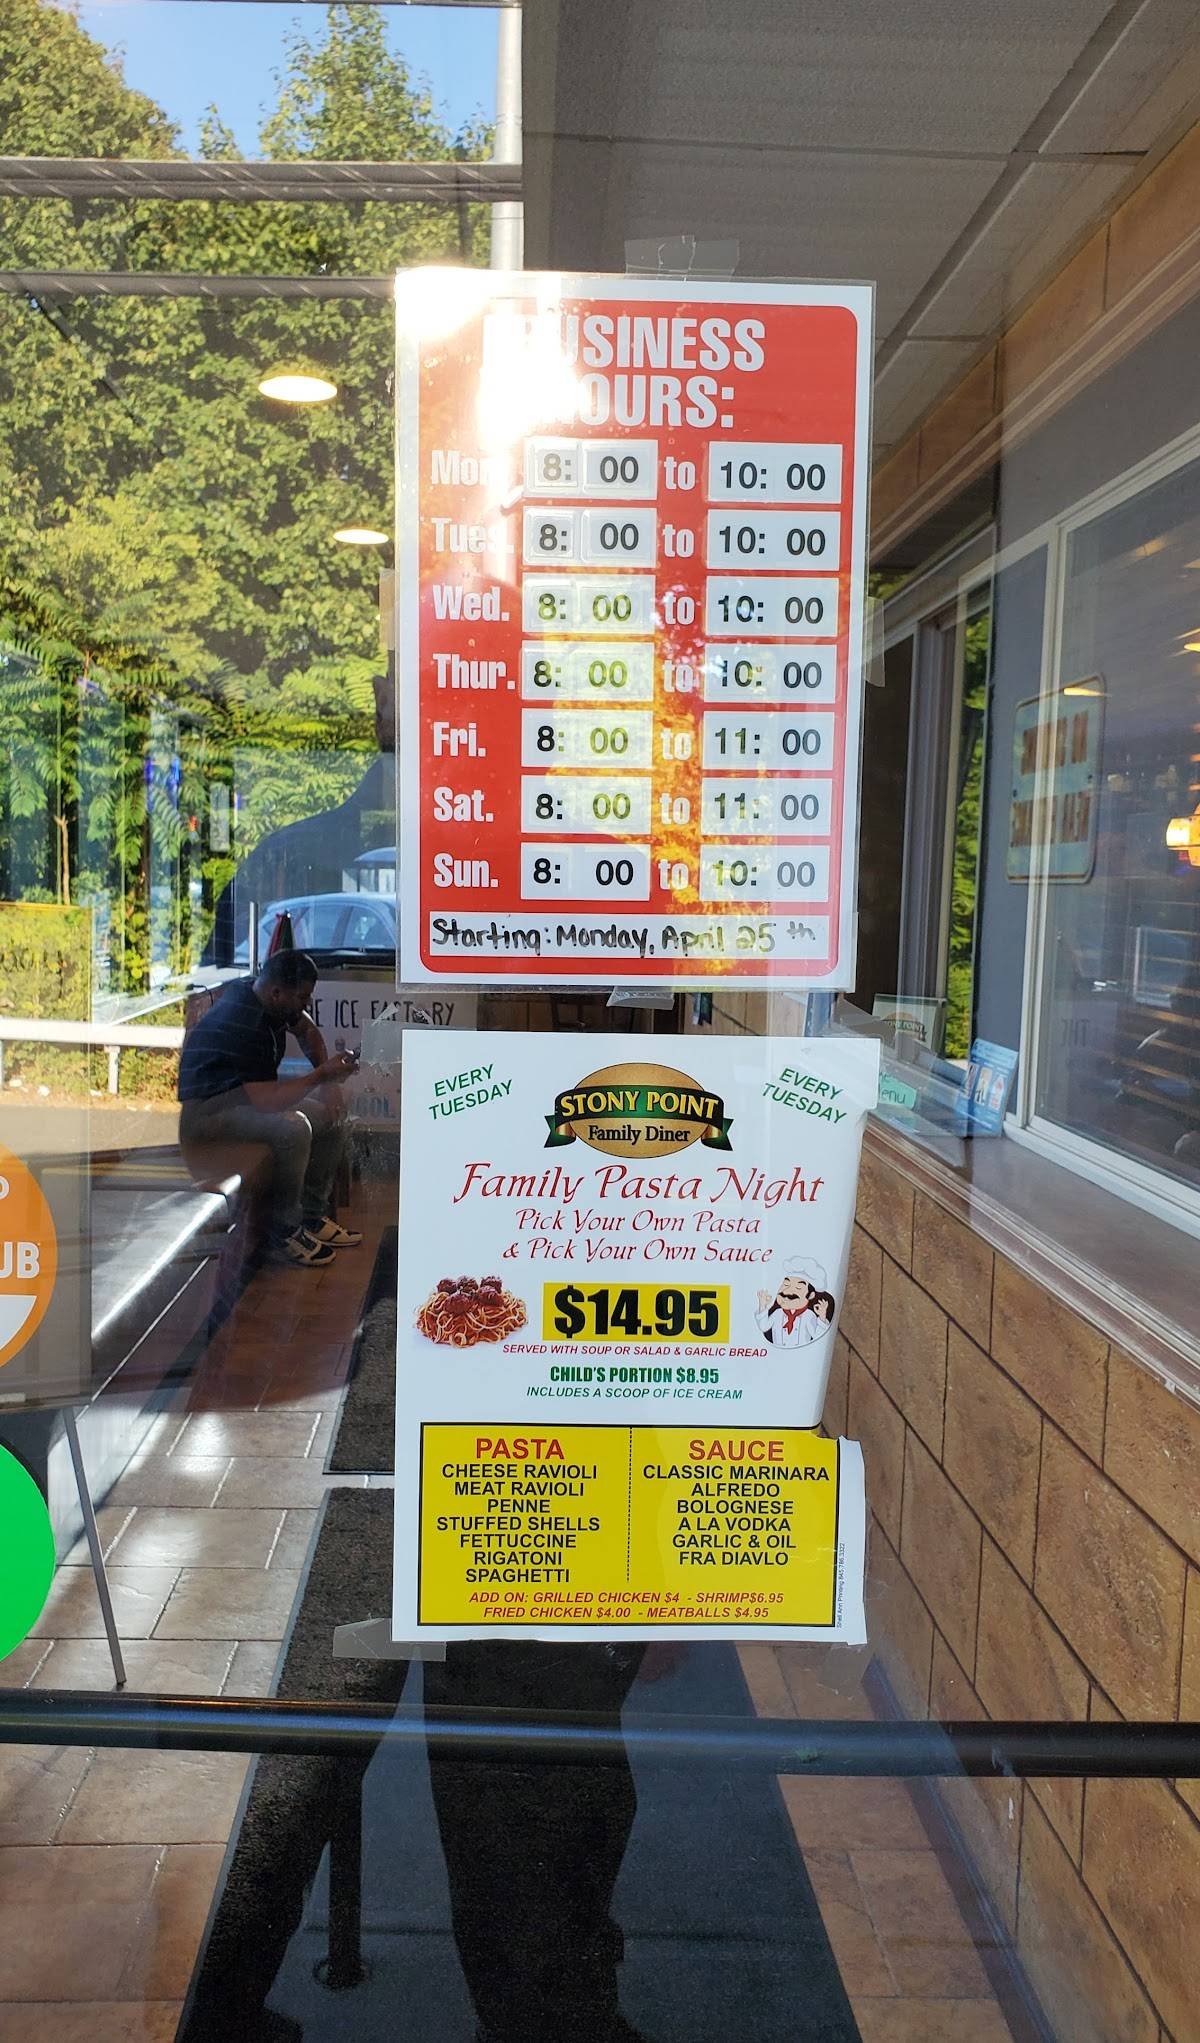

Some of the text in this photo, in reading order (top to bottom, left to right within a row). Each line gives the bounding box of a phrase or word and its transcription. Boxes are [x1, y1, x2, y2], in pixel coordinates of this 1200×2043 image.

[509, 315, 766, 372] USINESS
[540, 374, 735, 428] OURS:
[431, 449, 826, 490] Mo 8: 00 to 10: 00
[431, 517, 826, 557] Tues. 8: 00 to 10: 00
[432, 585, 824, 626] Wed. 8: 00 to 10: 00
[433, 653, 822, 693] Thur. 8: 00 to 10: 00
[433, 722, 821, 761] Fri. 8: 00 to 11: 00
[433, 787, 819, 825] Sat. 8: 00 to 11: 00
[433, 853, 815, 891] Sun. 8: 00 to 10: 00
[432, 918, 551, 956] Starting:
[556, 924, 654, 958] Monday,
[662, 925, 724, 956] April
[735, 922, 776, 953] 25
[334, 999, 360, 1029] ICE
[433, 1064, 495, 1098] EVERY
[779, 1067, 843, 1101] EVERY
[428, 1079, 514, 1121] TUESDAY
[560, 1089, 719, 1120] STONY POINT
[761, 1082, 847, 1125] TUESDAY
[588, 1125, 691, 1146] Family Diner
[453, 1163, 824, 1209] Family Pasta Night
[516, 1208, 760, 1235] Pick Your Own Pasta
[502, 1238, 772, 1263] & Pick Your Own Sauce
[553, 1285, 720, 1338] $14.95
[503, 1344, 768, 1357] SERVED WITH SOUP OR SALAD & GARLIC BREAD
[550, 1366, 719, 1384] CHILD'S PORTION $8.95
[526, 1386, 742, 1399] INCLUDES A SCOOP OF ICE CREAM
[475, 1437, 564, 1460] PASTA
[688, 1439, 785, 1462] SAUCE
[442, 1463, 597, 1480] CHEESE RAVIOLI
[642, 1464, 830, 1482] CLASSIC MARINARA
[454, 1481, 584, 1497] MEAT RAVIOLI
[690, 1482, 781, 1498] ALFREDO
[487, 1499, 551, 1514] PENNE
[676, 1500, 794, 1516] BOLOGNESE
[436, 1516, 600, 1532] STUFFED SHELLS
[678, 1517, 792, 1532] A LA VODKA
[460, 1534, 577, 1549] FETTUCCINE
[672, 1534, 796, 1550] GARLIC & OIL
[474, 1551, 562, 1567] RIGATONI
[679, 1551, 788, 1567] FRA DIAVLO
[465, 1568, 570, 1584] SPAGHETTI
[469, 1592, 501, 1603] ADD
[504, 1593, 529, 1603] ON:
[533, 1592, 594, 1603] GRILLED
[598, 1592, 661, 1603] CHICKEN
[665, 1592, 679, 1604] $4
[695, 1592, 784, 1604] SHRIMP$6.95
[483, 1607, 525, 1618] FRIED
[529, 1607, 592, 1618] CHICKEN
[596, 1607, 631, 1619] $4.00
[647, 1607, 730, 1618] MEATBALLS
[734, 1607, 769, 1619] $4.95
